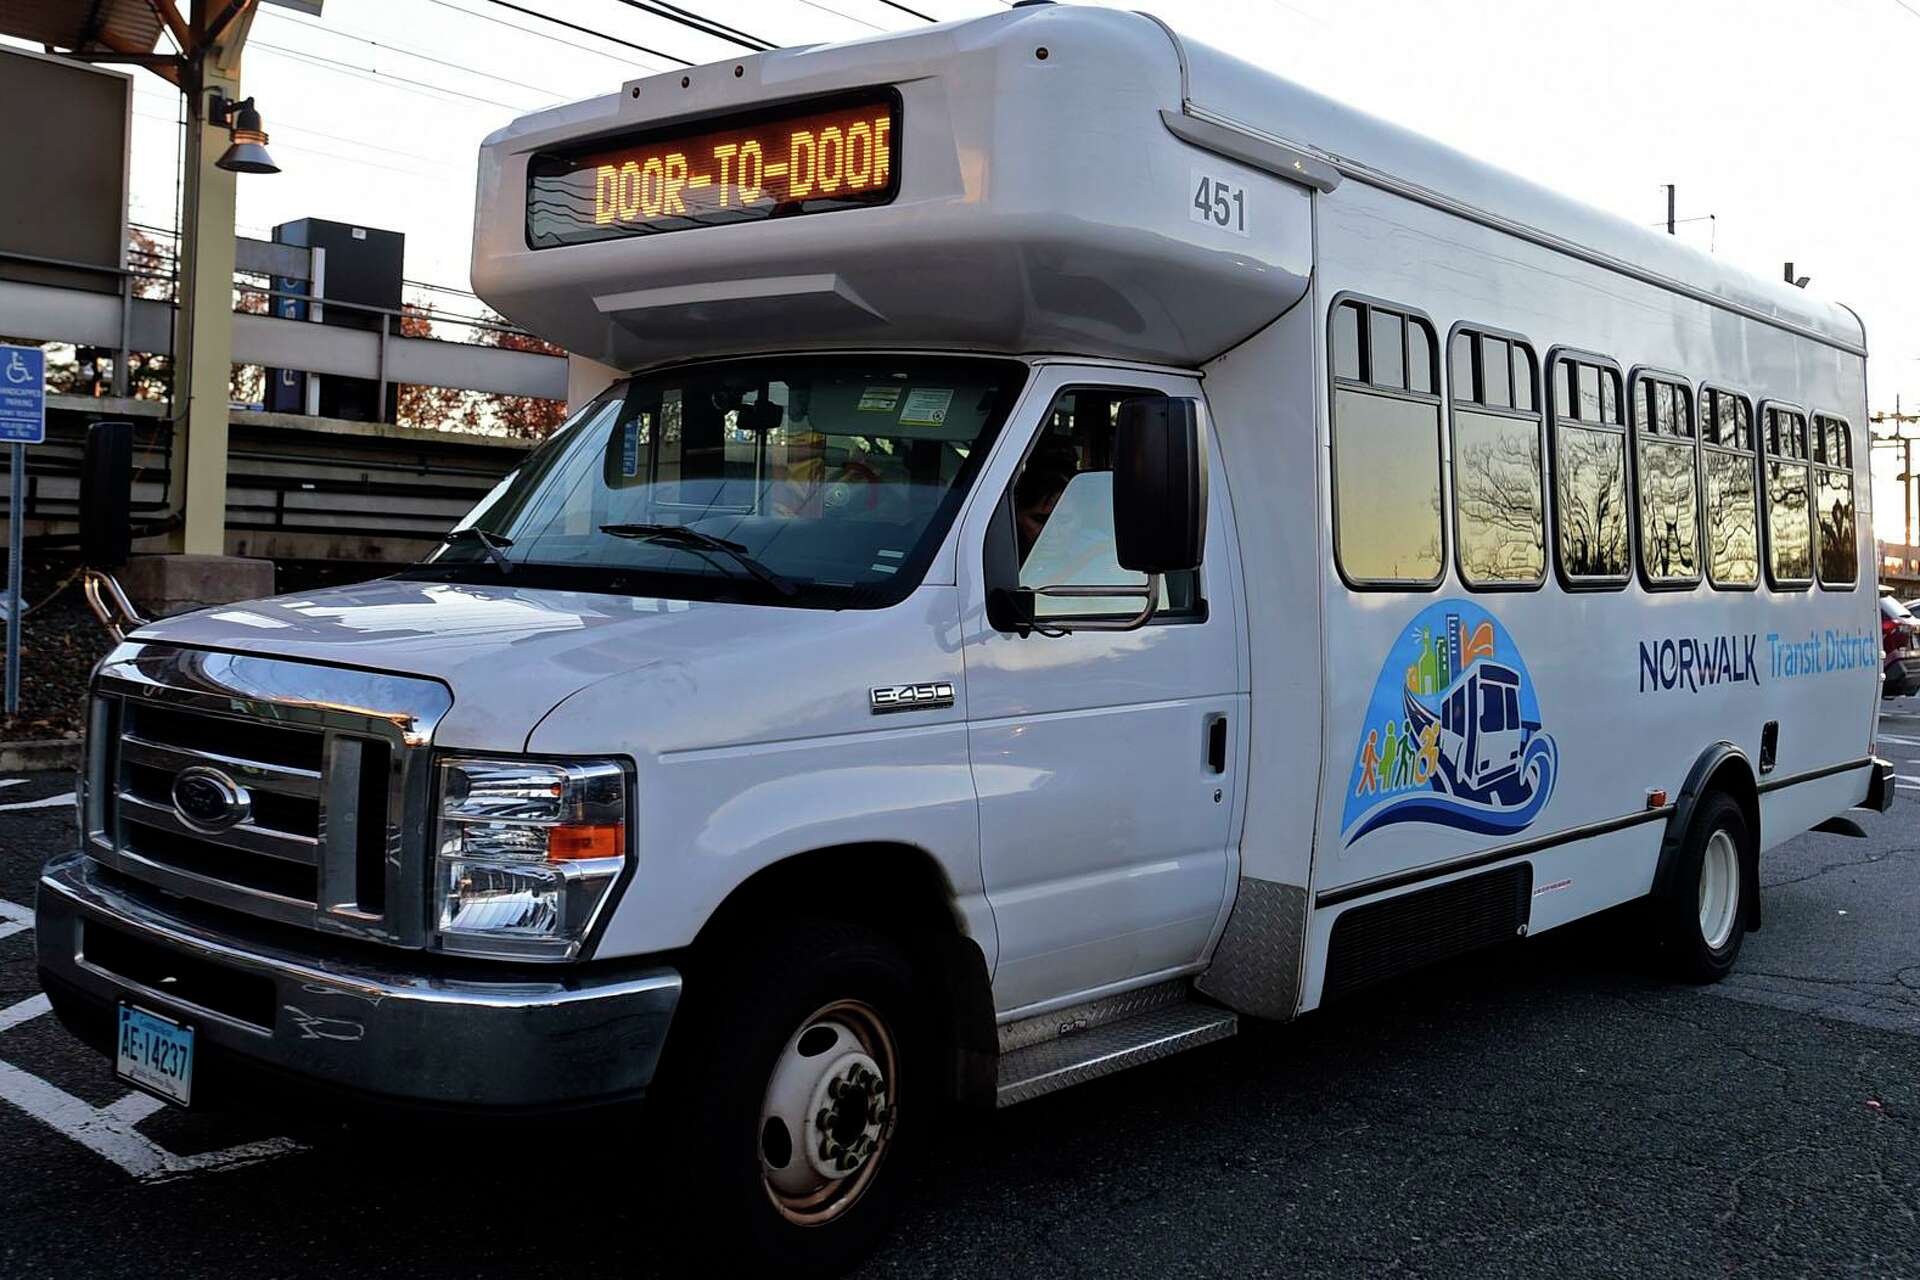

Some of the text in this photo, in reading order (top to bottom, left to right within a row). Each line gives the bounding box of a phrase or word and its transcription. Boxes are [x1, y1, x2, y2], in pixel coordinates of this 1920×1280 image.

[1194, 176, 1244, 231] 451
[1639, 627, 1876, 693] NORWALK Transit District
